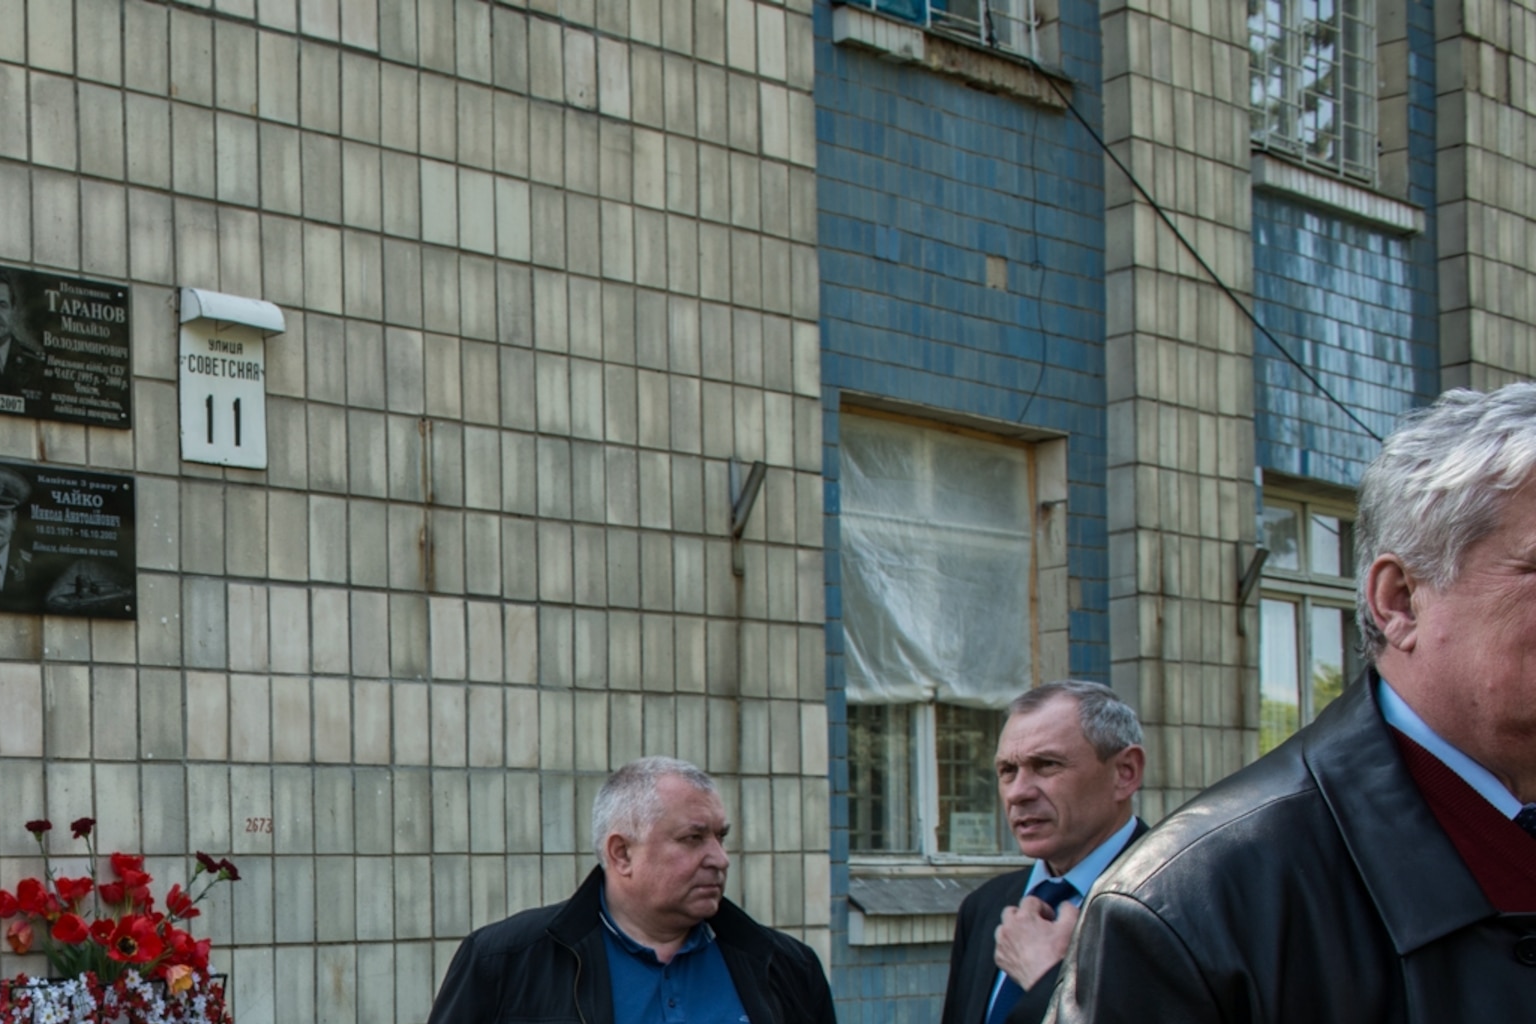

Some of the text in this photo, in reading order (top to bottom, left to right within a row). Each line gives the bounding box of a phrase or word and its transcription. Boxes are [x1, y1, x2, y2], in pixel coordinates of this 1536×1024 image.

[44, 289, 126, 323] ТАРАНОВ
[208, 339, 244, 355] УЛИЦА
[188, 354, 260, 381] СОВЕТСКАЯ
[0, 397, 22, 410] 2007
[205, 394, 242, 447] 11
[37, 475, 78, 486] Капітан
[80, 479, 87, 487] 3
[51, 489, 104, 508] ЧАЙКО
[245, 817, 273, 834] 2673
